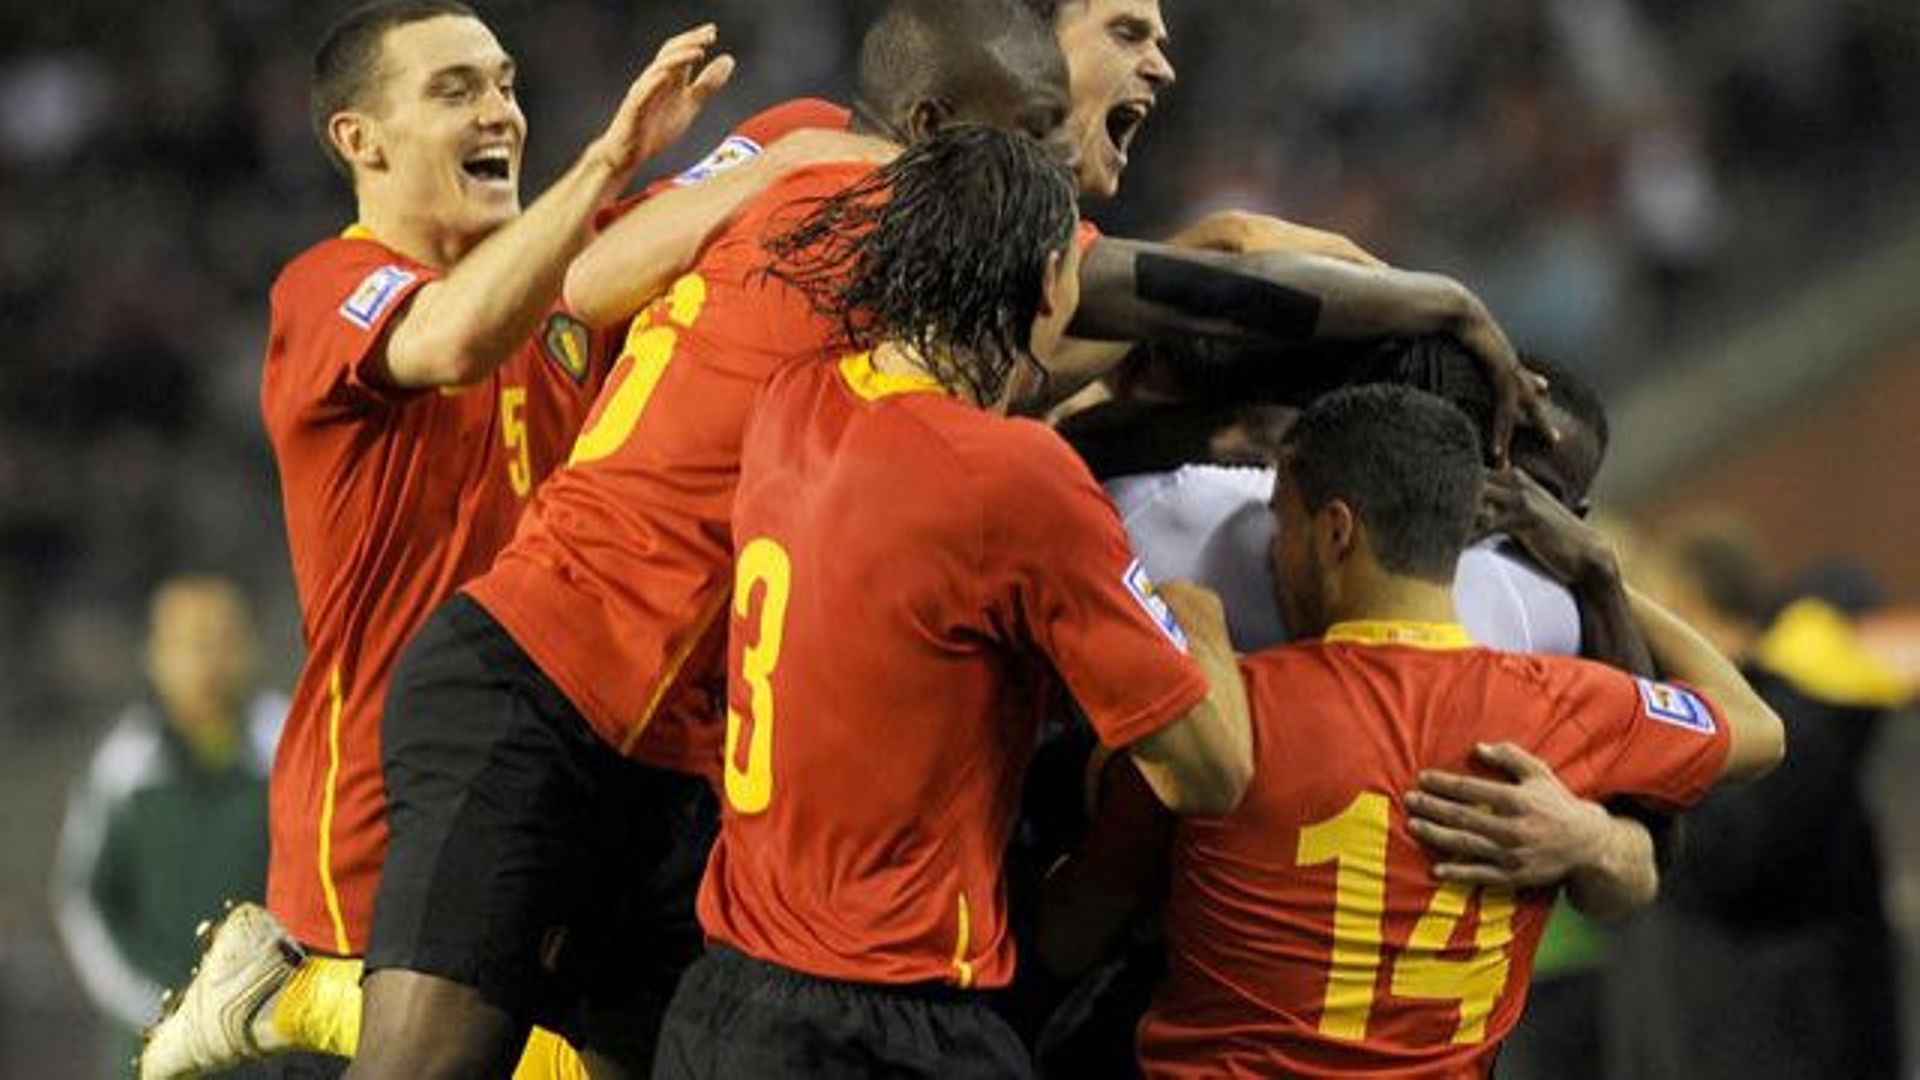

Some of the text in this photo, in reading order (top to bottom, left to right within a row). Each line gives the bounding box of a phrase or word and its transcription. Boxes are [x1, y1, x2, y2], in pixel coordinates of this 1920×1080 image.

[502, 386, 531, 496] 5
[725, 537, 791, 814] 3
[1296, 790, 1516, 1044] 14
